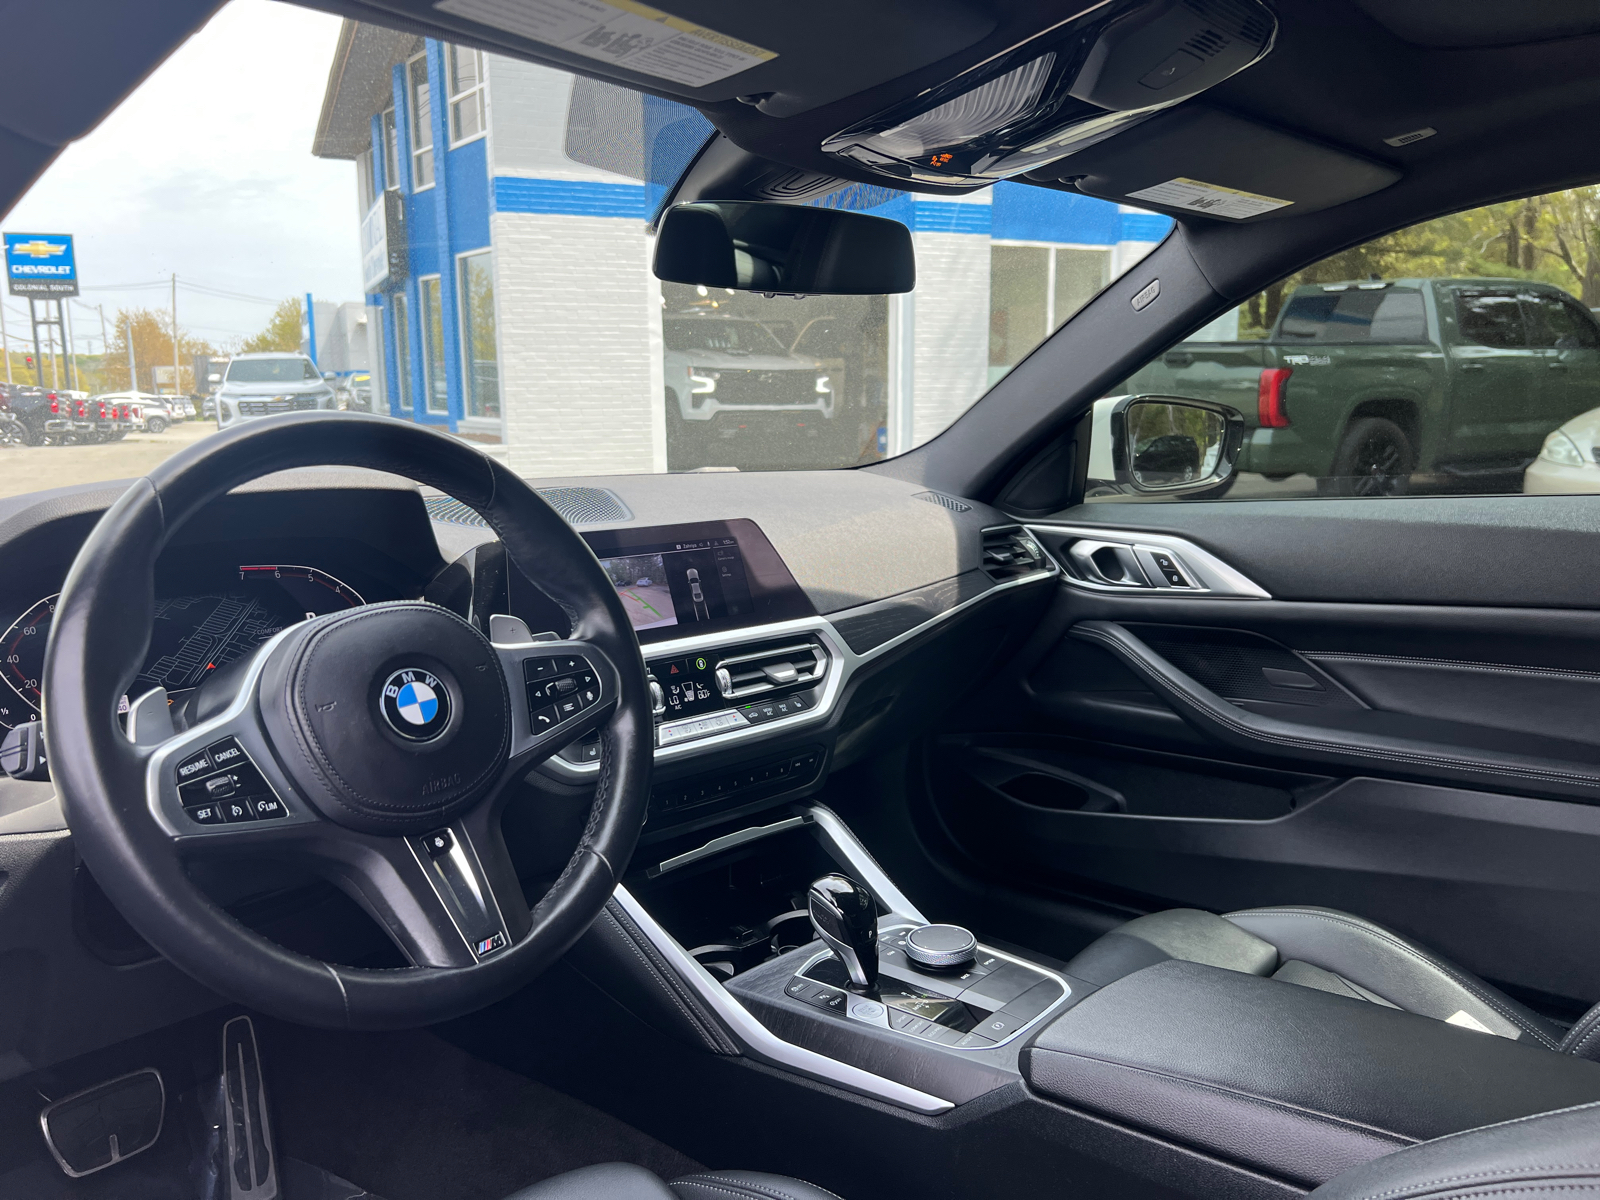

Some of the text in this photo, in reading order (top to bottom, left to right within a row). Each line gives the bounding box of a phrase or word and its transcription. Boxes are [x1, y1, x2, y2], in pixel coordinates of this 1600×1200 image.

[12, 265, 71, 275] CHEVROLET
[13, 283, 75, 292] COLONIAL SOUTH
[239, 571, 245, 580] 7
[274, 570, 281, 579] 6
[308, 573, 314, 582] 5
[335, 585, 341, 594] 4
[23, 626, 36, 636] 60
[256, 626, 284, 635] COMFORT
[6, 654, 20, 664] 40
[24, 678, 38, 689] 20
[386, 671, 438, 698] BMW
[30, 713, 36, 721] 0
[214, 747, 241, 763] CANCEL
[179, 758, 209, 776] RESUME
[422, 772, 462, 796] AIRBAG
[265, 801, 278, 812] LIM
[197, 808, 212, 819] SET
